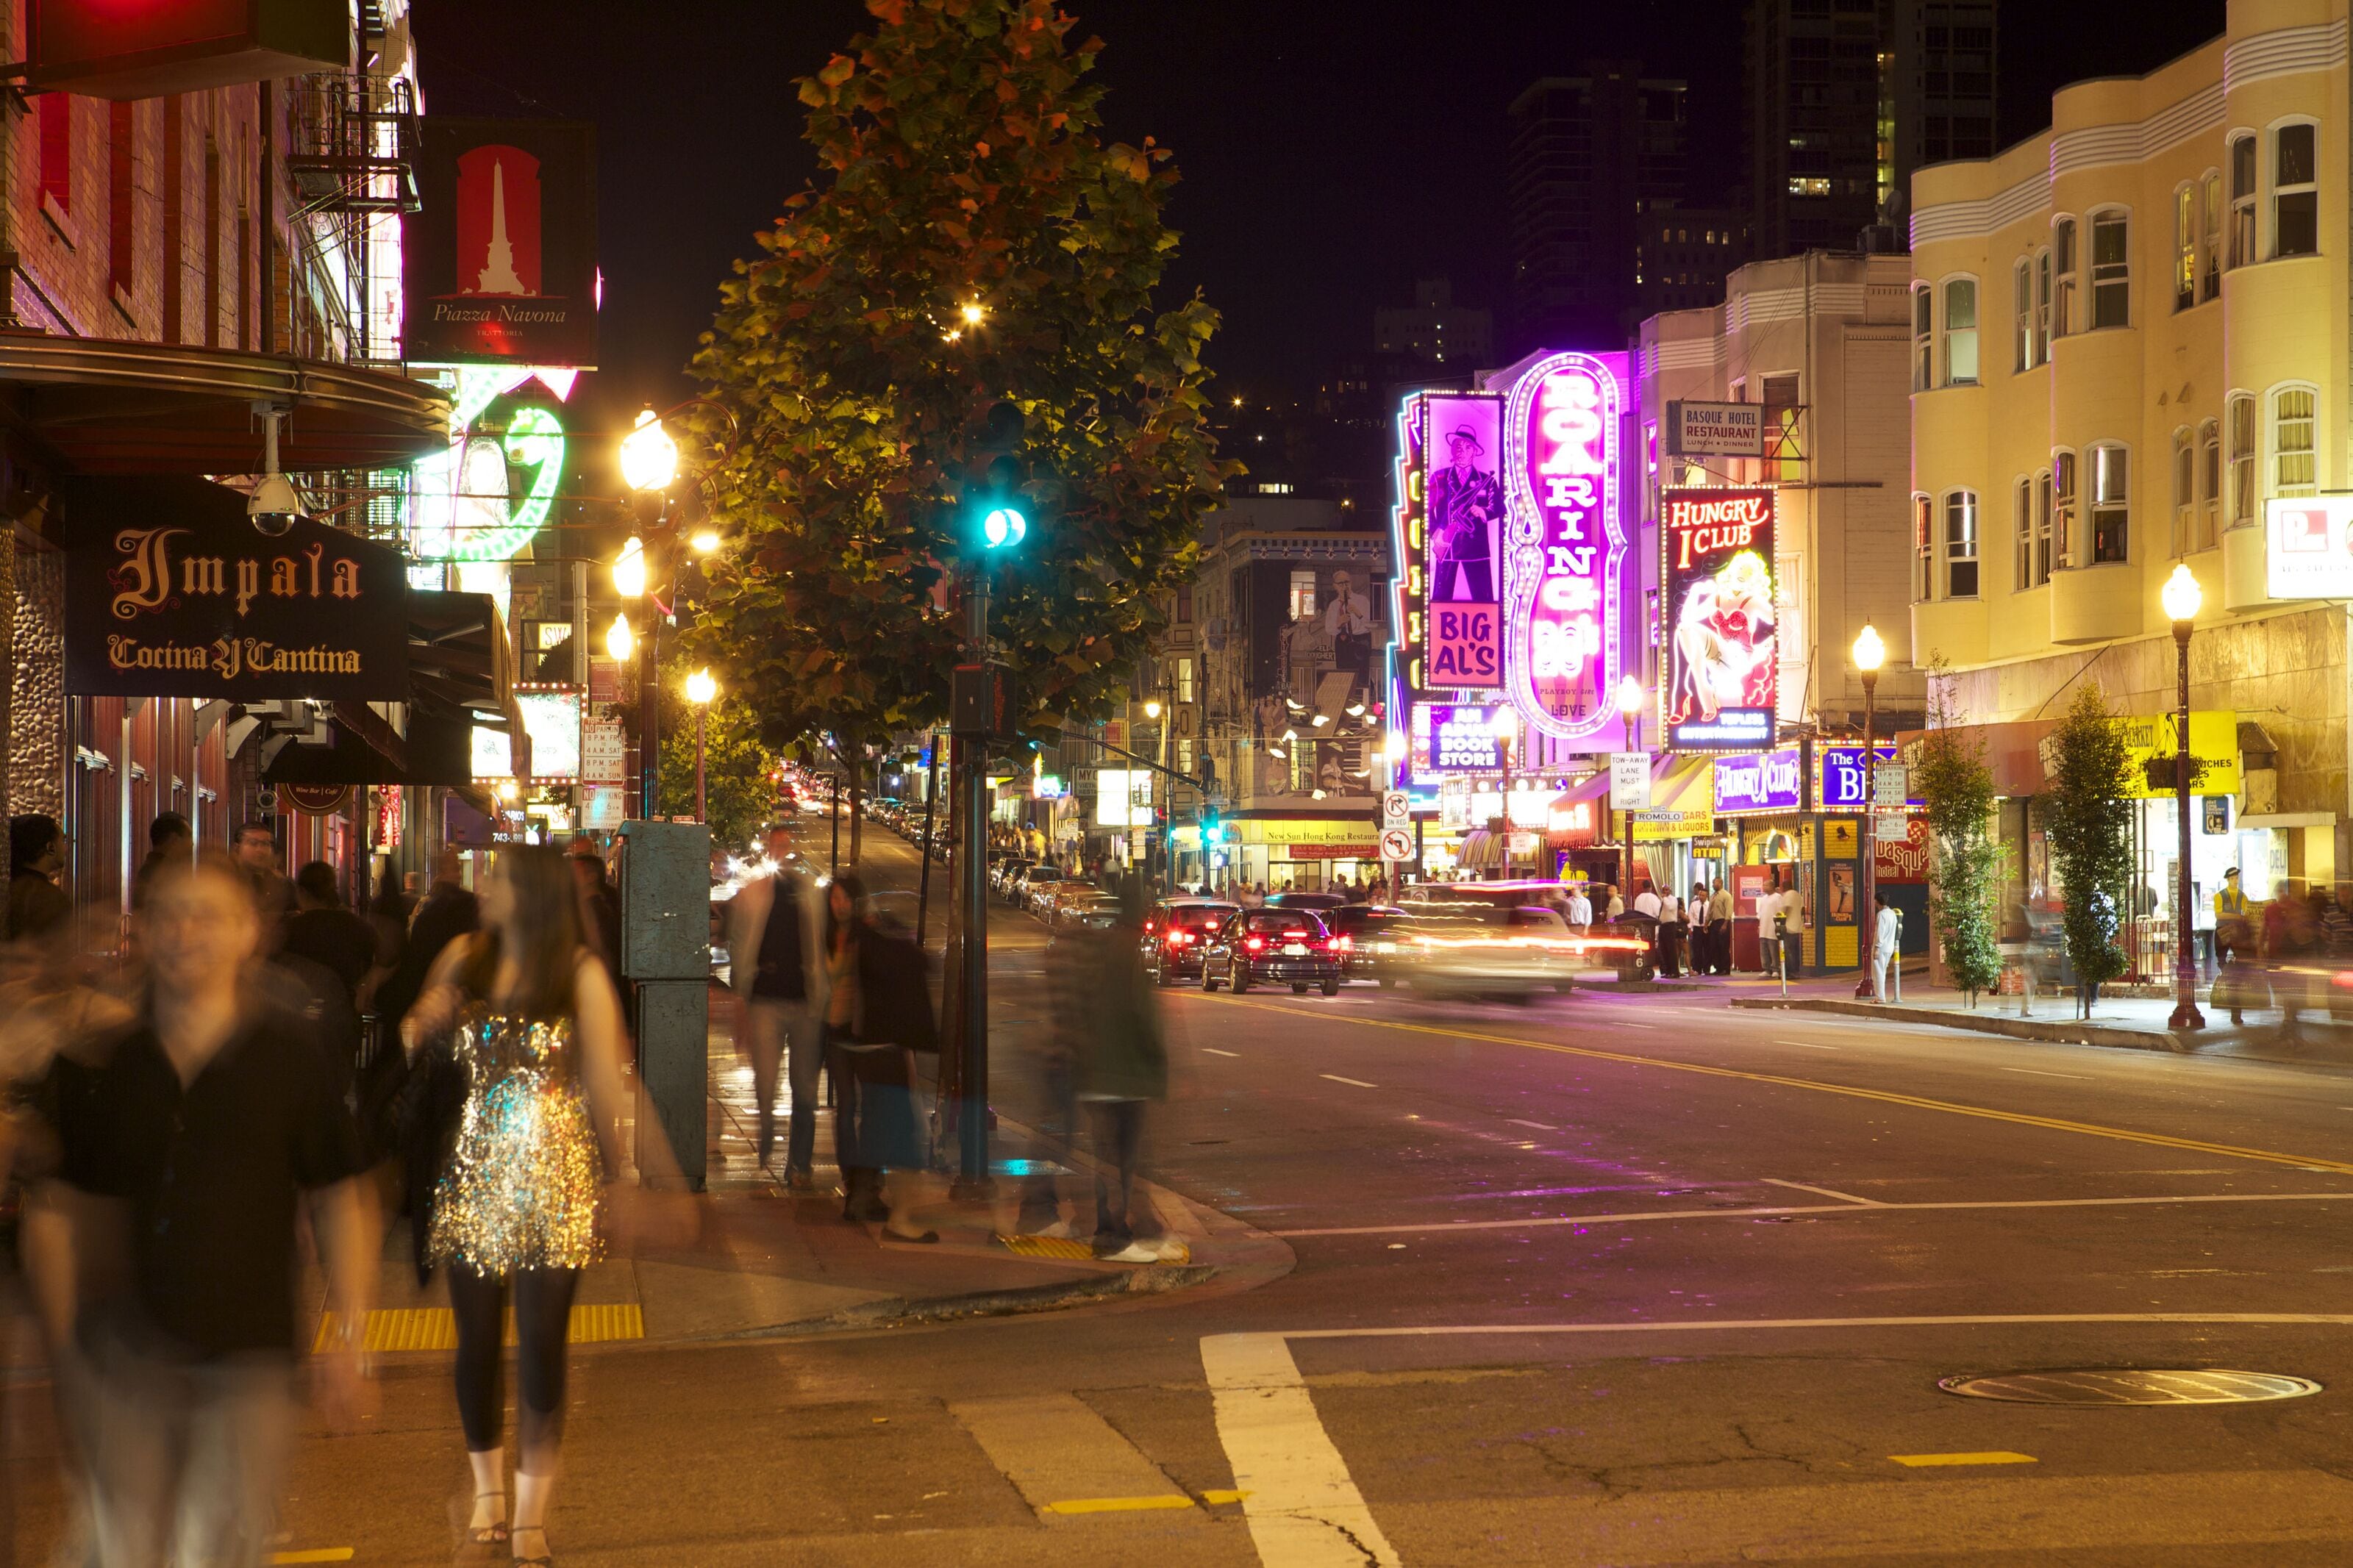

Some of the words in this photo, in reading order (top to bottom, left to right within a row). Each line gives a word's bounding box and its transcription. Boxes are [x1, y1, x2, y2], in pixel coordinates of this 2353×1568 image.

[434, 304, 491, 321] Piazza
[498, 305, 566, 323] Navona
[1686, 410, 1723, 423] BASQUE
[1728, 412, 1757, 425] HOTEL
[1686, 426, 1757, 439] RESTAURANT
[1670, 497, 1769, 527] HUNGRY
[1693, 524, 1752, 554] CLUB
[112, 526, 363, 620] Impala
[1440, 611, 1492, 642] BIG
[108, 634, 209, 670] Cocina
[243, 637, 362, 674] Cantina
[1433, 642, 1496, 676] AL'S
[1551, 704, 1587, 717] LOVE
[585, 724, 595, 733] NO
[1440, 737, 1496, 751] BOOK
[1439, 751, 1496, 766] STORE
[1829, 752, 1854, 765] The
[583, 789, 595, 801] NO
[596, 792, 622, 800] PARKING
[1671, 823, 1677, 831] &
[1679, 822, 1710, 831] LIQUORS
[1268, 832, 1285, 840] New
[1287, 832, 1301, 840] Sun
[1303, 832, 1324, 842] Hong
[1325, 832, 1346, 842] Kong
[1347, 832, 1379, 840] Restaura
[1693, 837, 1715, 850] Swipe
[1693, 848, 1721, 858] ATM
[1876, 864, 1899, 878] hotel
